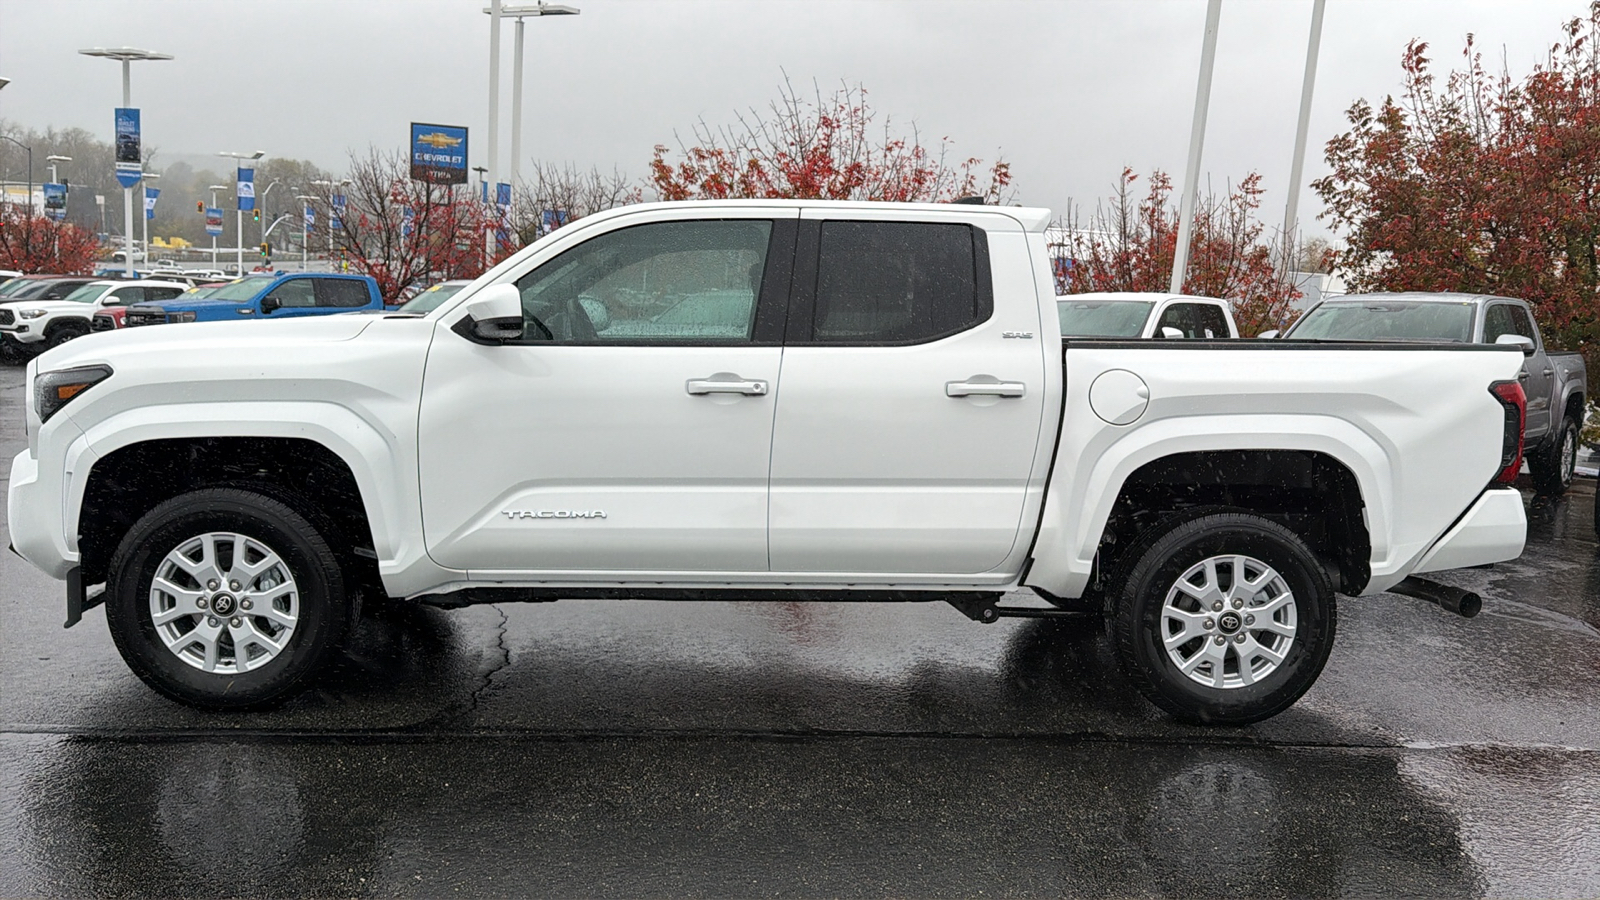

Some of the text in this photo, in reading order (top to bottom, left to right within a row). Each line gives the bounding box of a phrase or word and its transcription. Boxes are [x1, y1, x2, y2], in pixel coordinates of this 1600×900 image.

[415, 152, 463, 164] CHEVROLET
[426, 170, 451, 179] THIA
[501, 510, 607, 519] TACOMA
